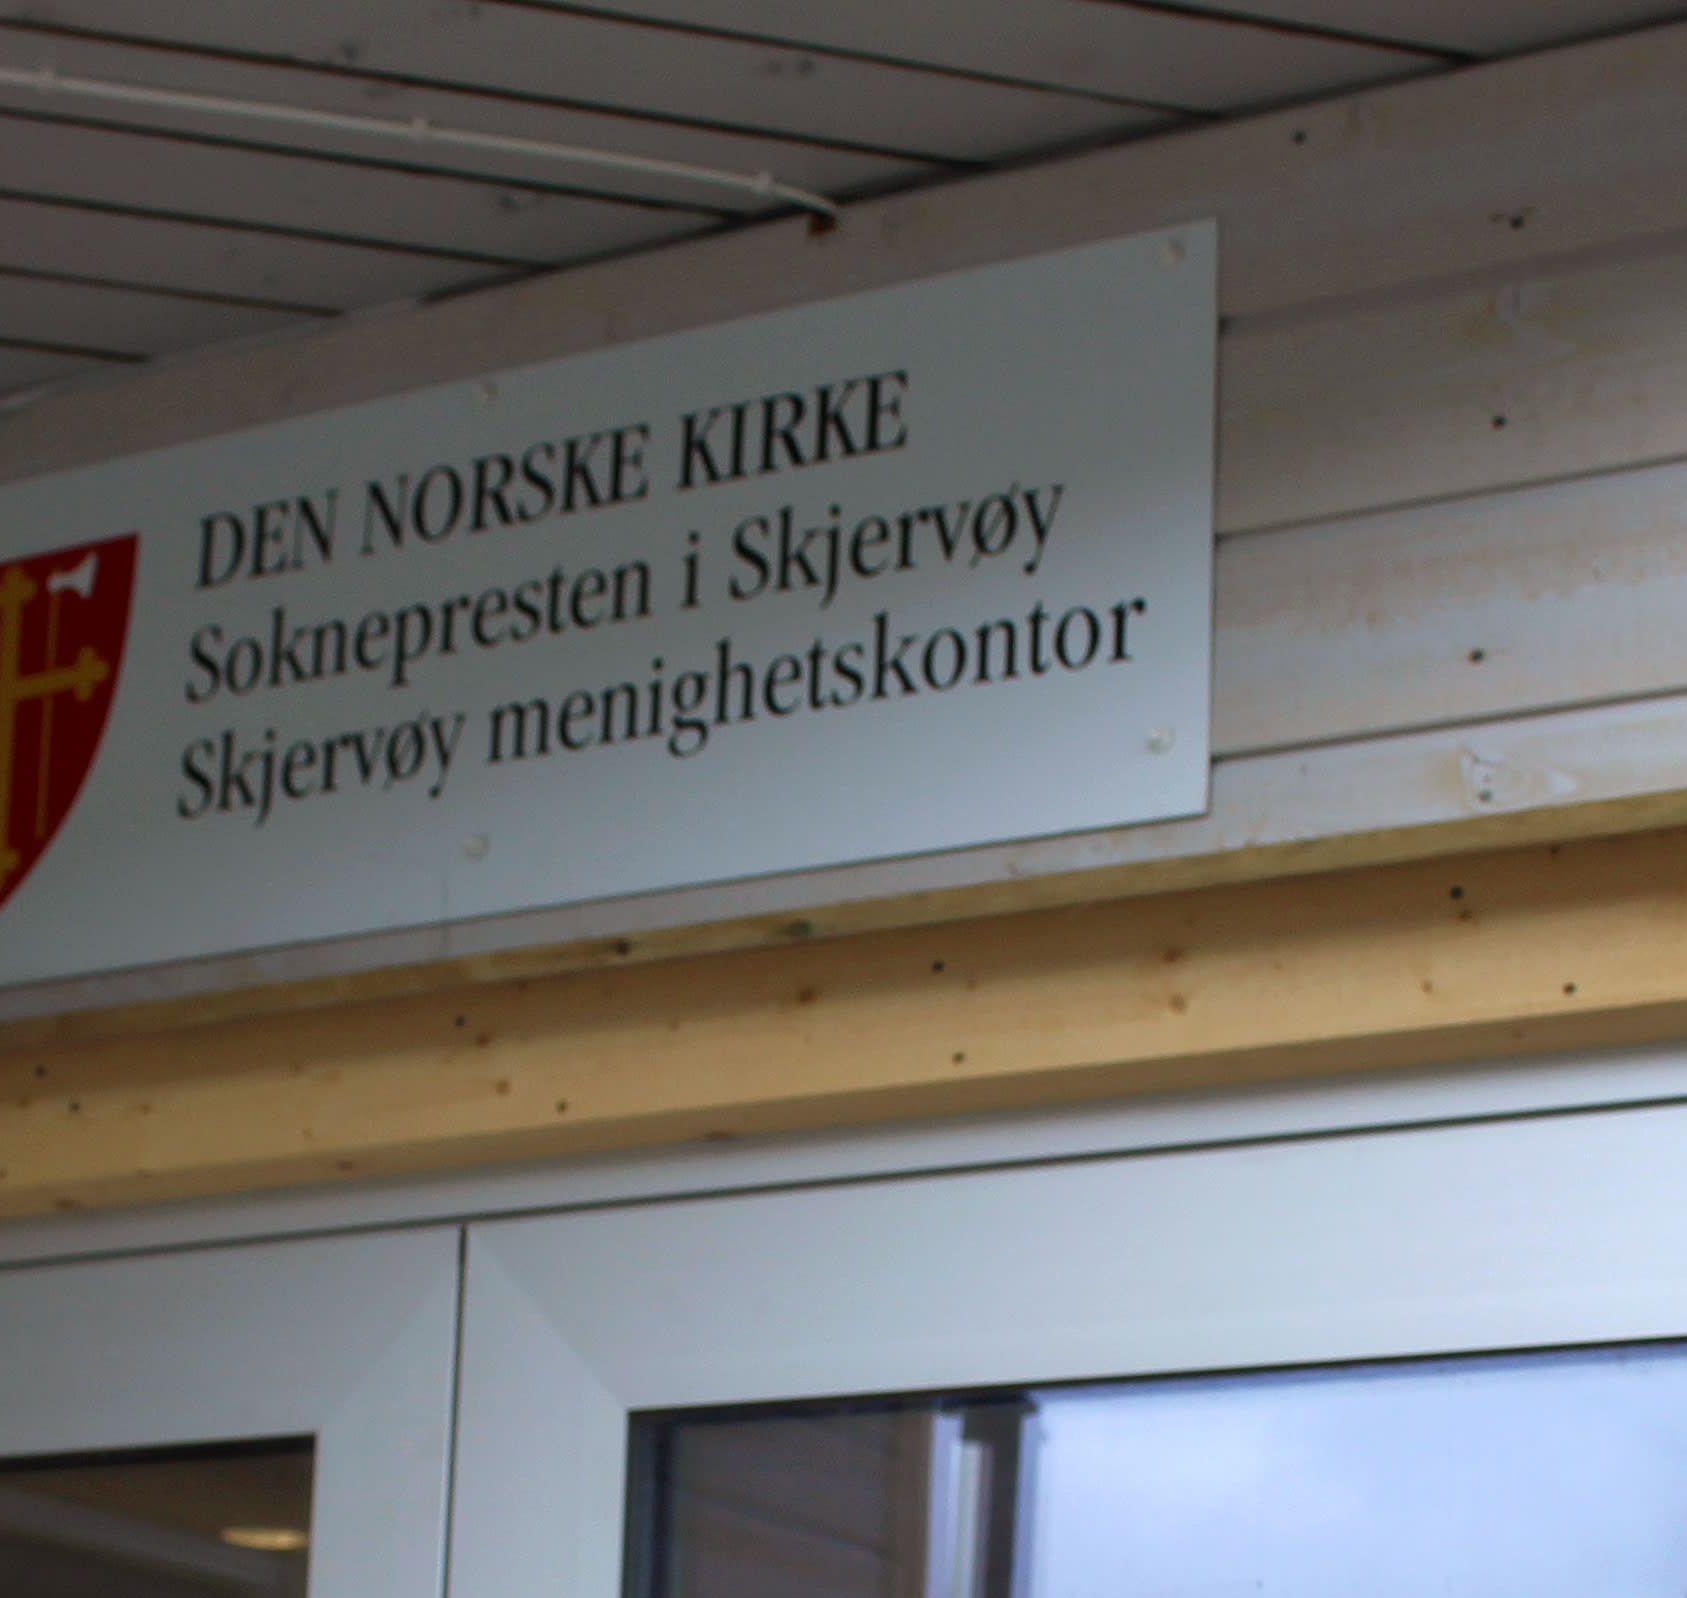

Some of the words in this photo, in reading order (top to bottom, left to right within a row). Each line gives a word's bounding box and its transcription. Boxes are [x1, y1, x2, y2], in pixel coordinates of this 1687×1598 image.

[195, 489, 339, 591] DEN
[358, 423, 651, 560] NORSKE
[676, 369, 910, 492] KIRKE
[184, 559, 653, 706] Soknepresten
[679, 530, 703, 610] i
[727, 483, 1066, 610] Skjervøy
[175, 699, 468, 828] Skjervøy
[486, 597, 1148, 766] menighetskontor
